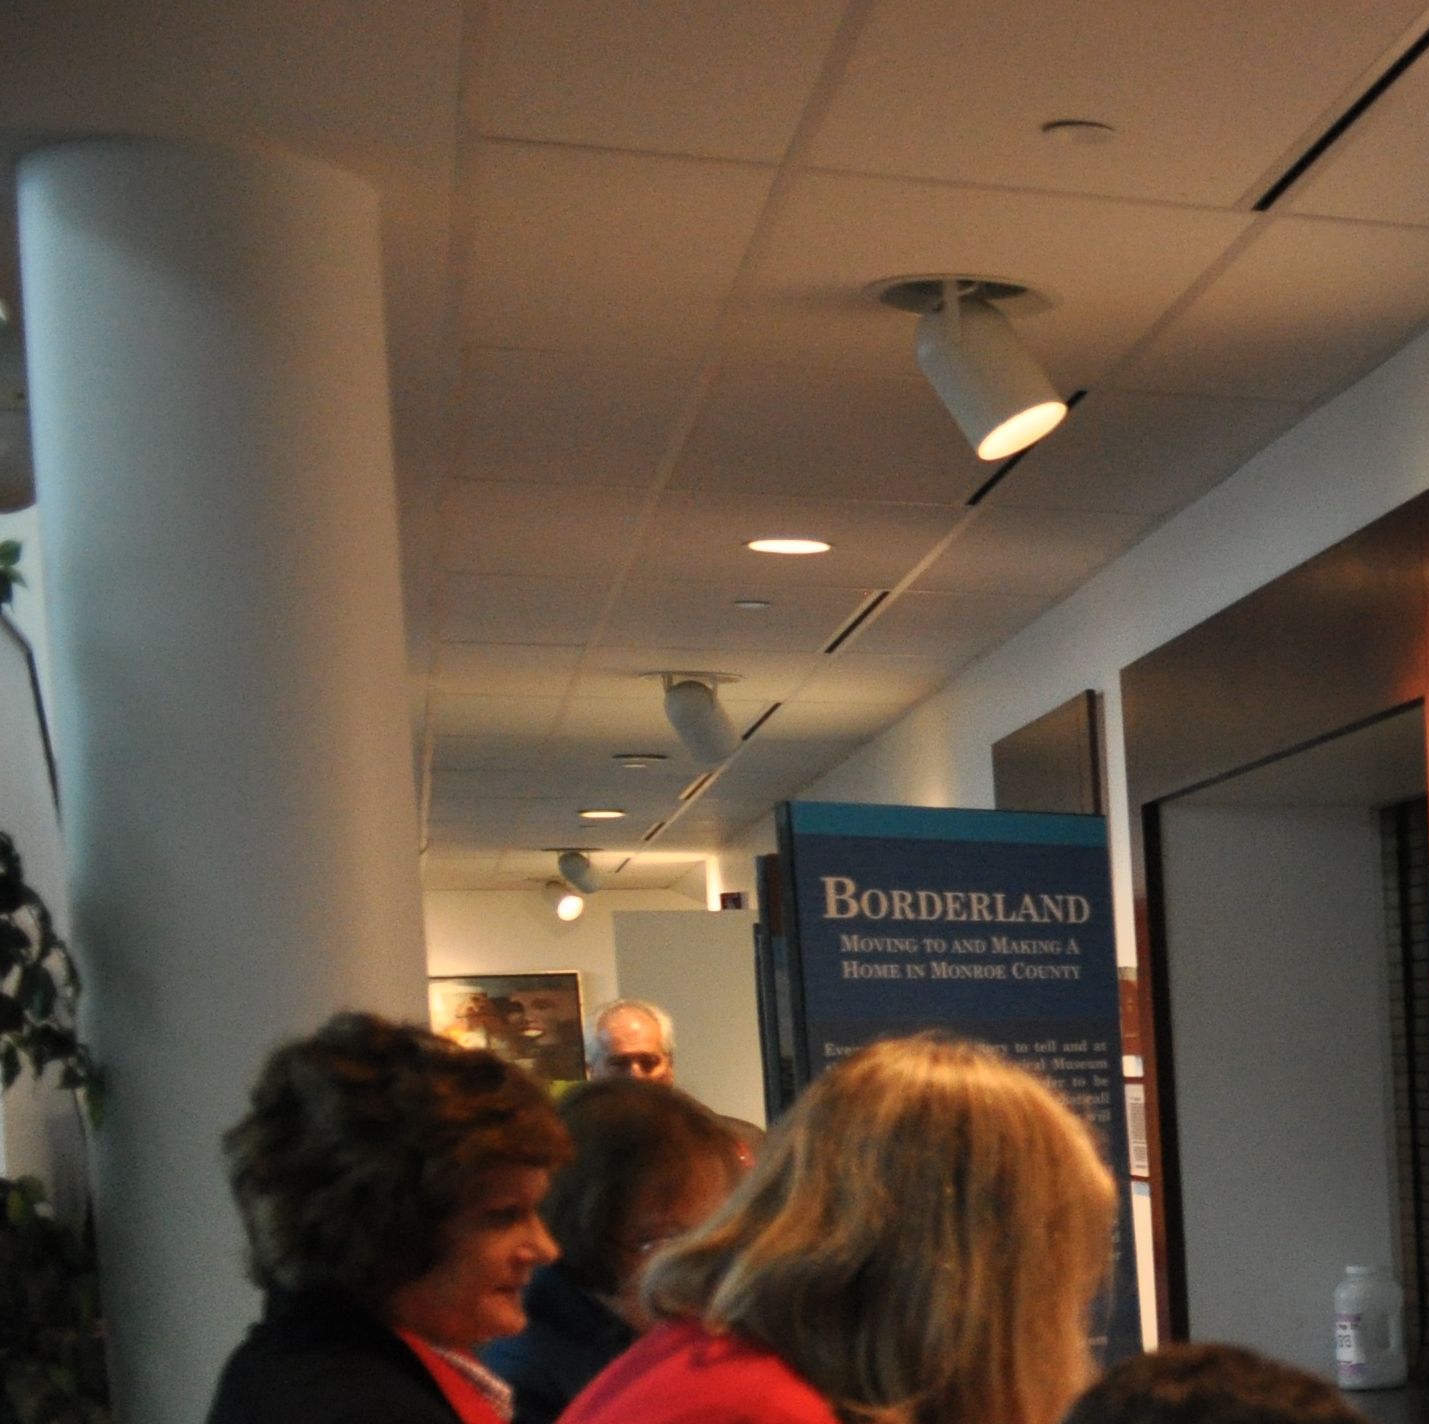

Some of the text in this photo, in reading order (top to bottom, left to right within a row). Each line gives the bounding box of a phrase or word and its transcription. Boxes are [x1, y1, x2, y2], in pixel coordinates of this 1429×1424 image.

[820, 875, 1091, 924] BORDERLAND
[840, 934, 1081, 955] MOVING TO AND MAKING A
[841, 960, 1081, 980] HOME IN MONROE COUNTY
[1034, 1039, 1057, 1053] tell
[1063, 1039, 1087, 1053] and
[1053, 1057, 1108, 1070] Museum
